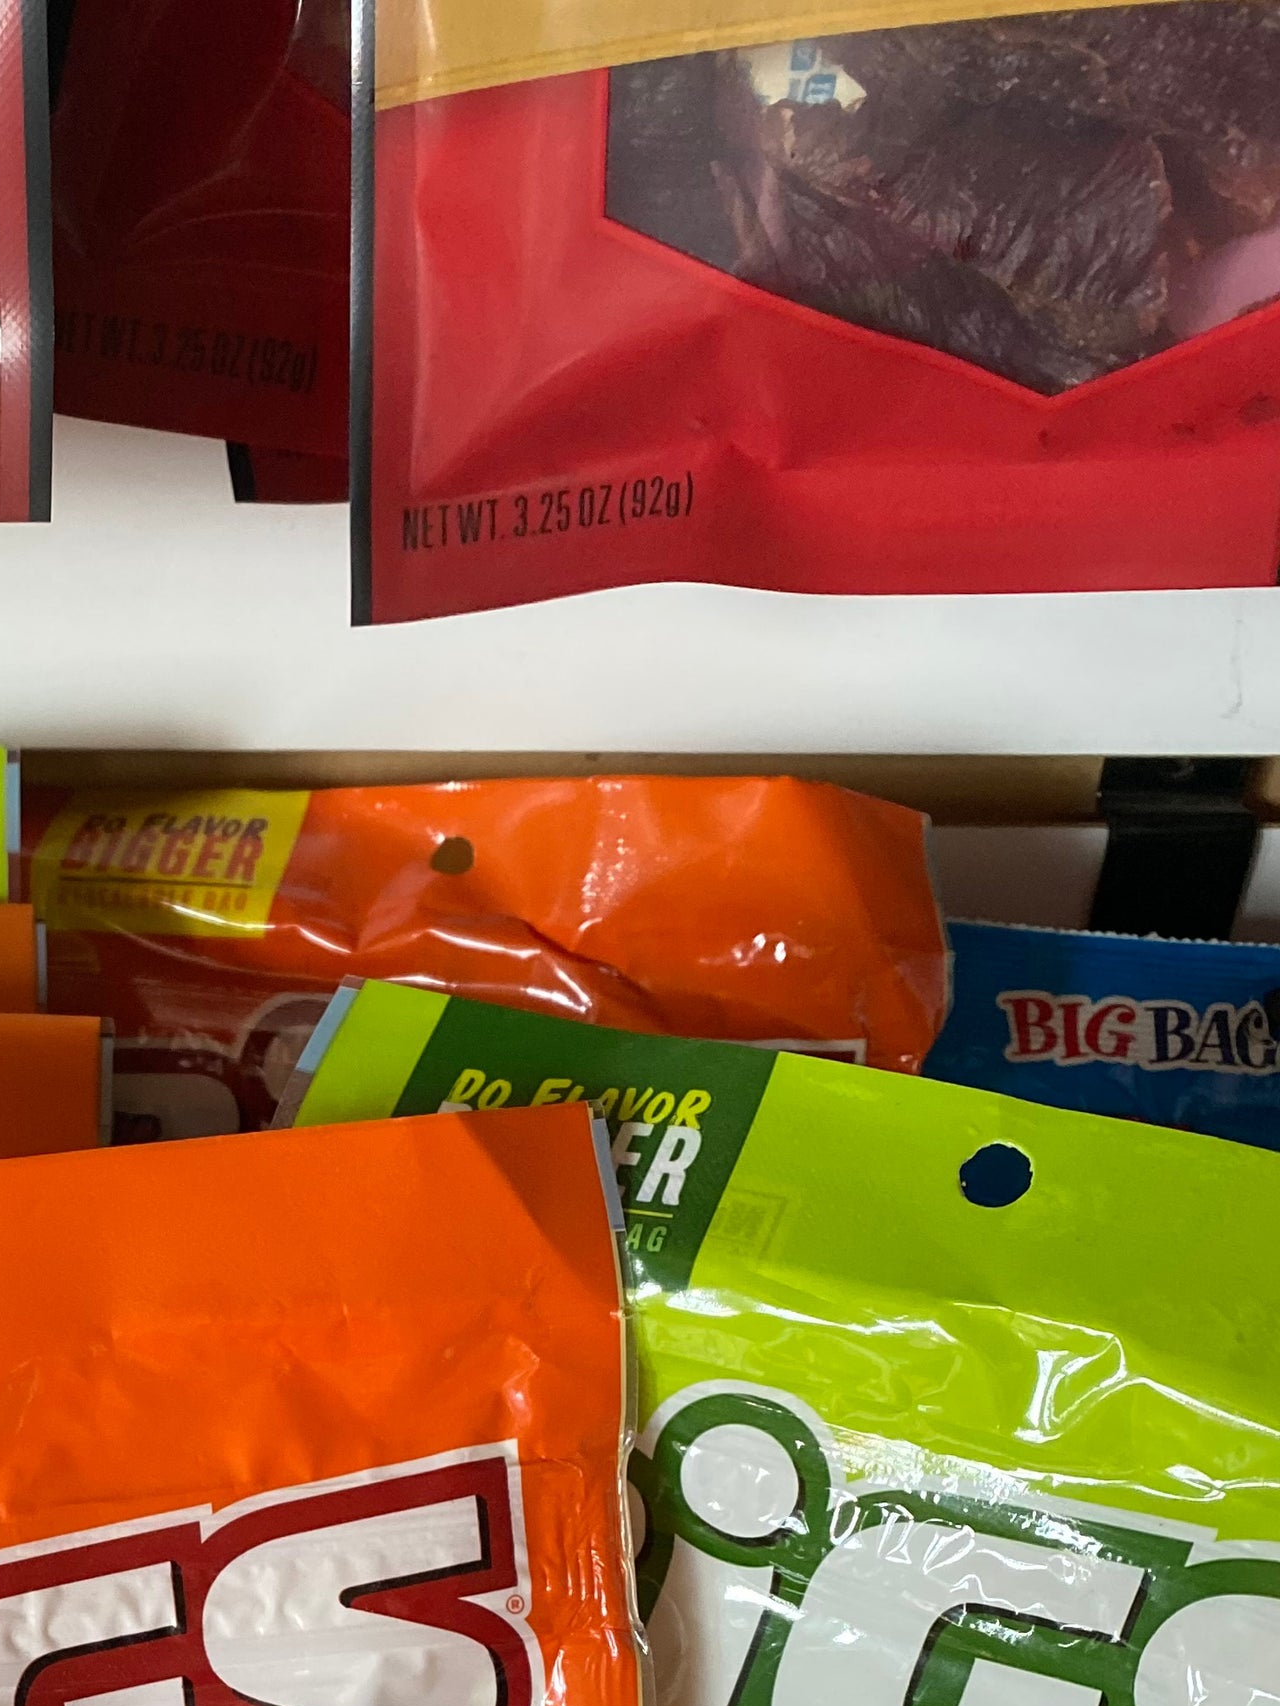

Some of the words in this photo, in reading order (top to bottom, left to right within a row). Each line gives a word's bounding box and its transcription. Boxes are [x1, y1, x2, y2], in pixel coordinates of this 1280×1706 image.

[403, 504, 450, 549] NET
[458, 498, 505, 544] WT.
[513, 490, 570, 537] 3.25
[579, 485, 612, 527] OZ
[620, 471, 693, 525] (92g)
[1001, 997, 1136, 1060] BIG
[1144, 1006, 1278, 1069] BAG
[448, 1069, 512, 1110] DO
[627, 1223, 668, 1252] AG
